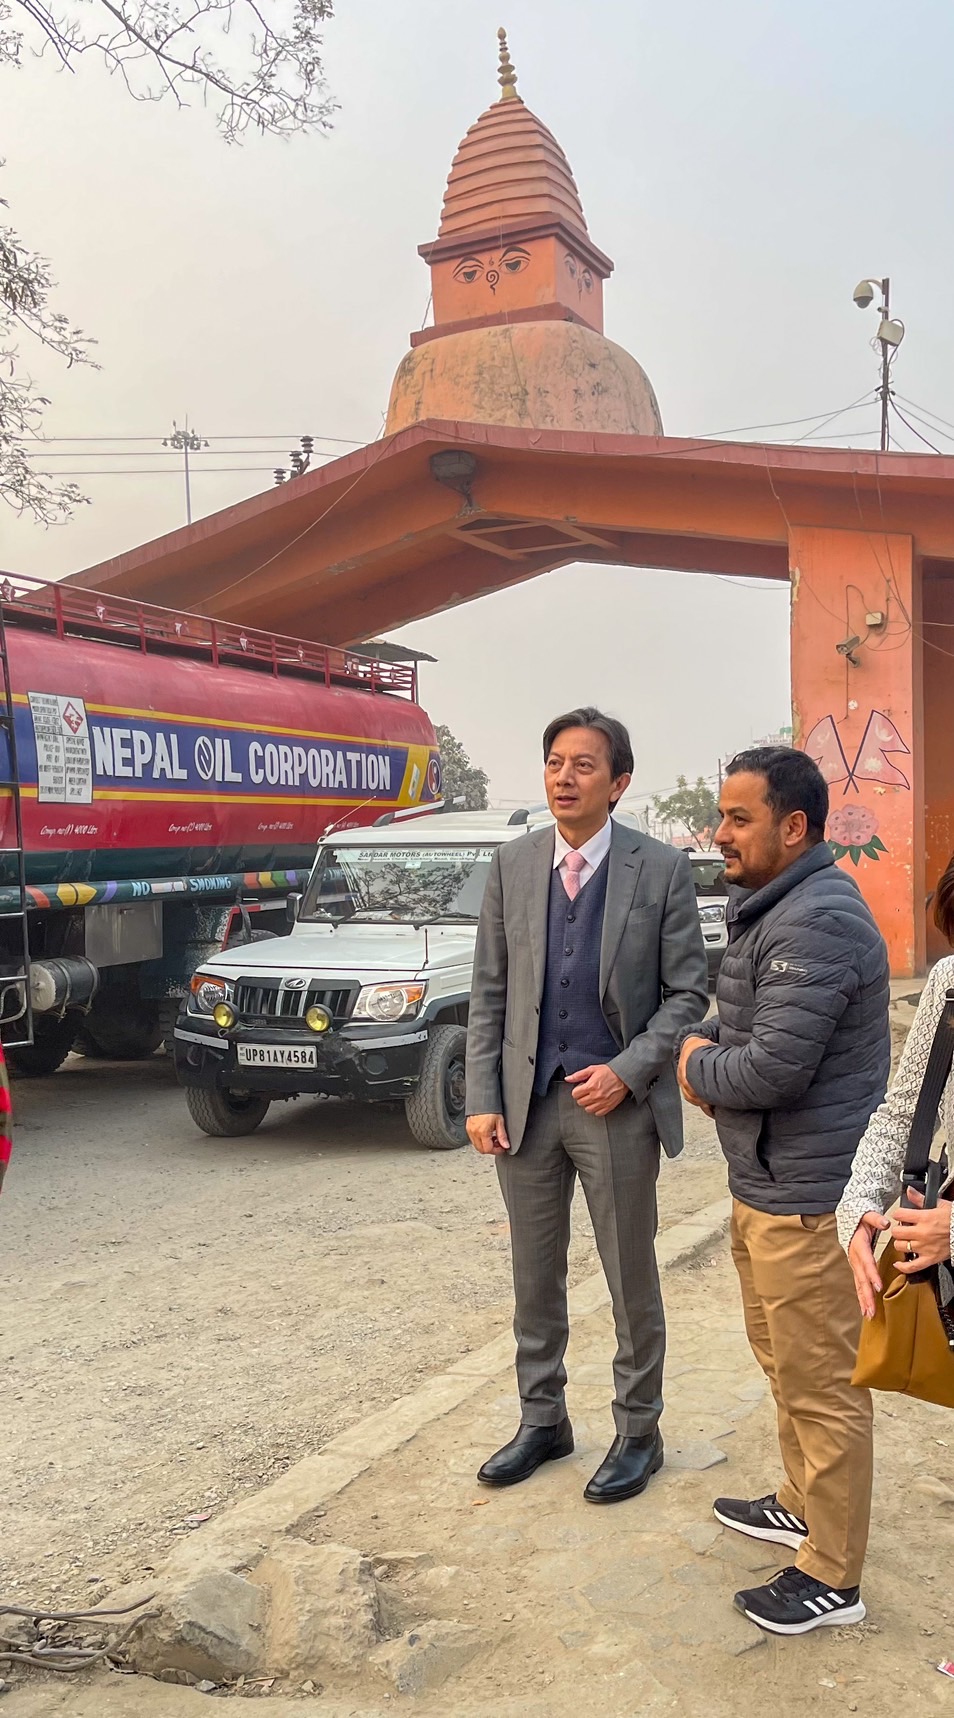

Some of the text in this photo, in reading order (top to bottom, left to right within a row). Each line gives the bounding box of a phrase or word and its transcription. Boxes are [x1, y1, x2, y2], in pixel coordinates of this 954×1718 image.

[92, 726, 391, 791] NEPAL OIL CORPORATION
[131, 877, 232, 897] NO SMOKING
[245, 1048, 314, 1065] UP81AY4584
